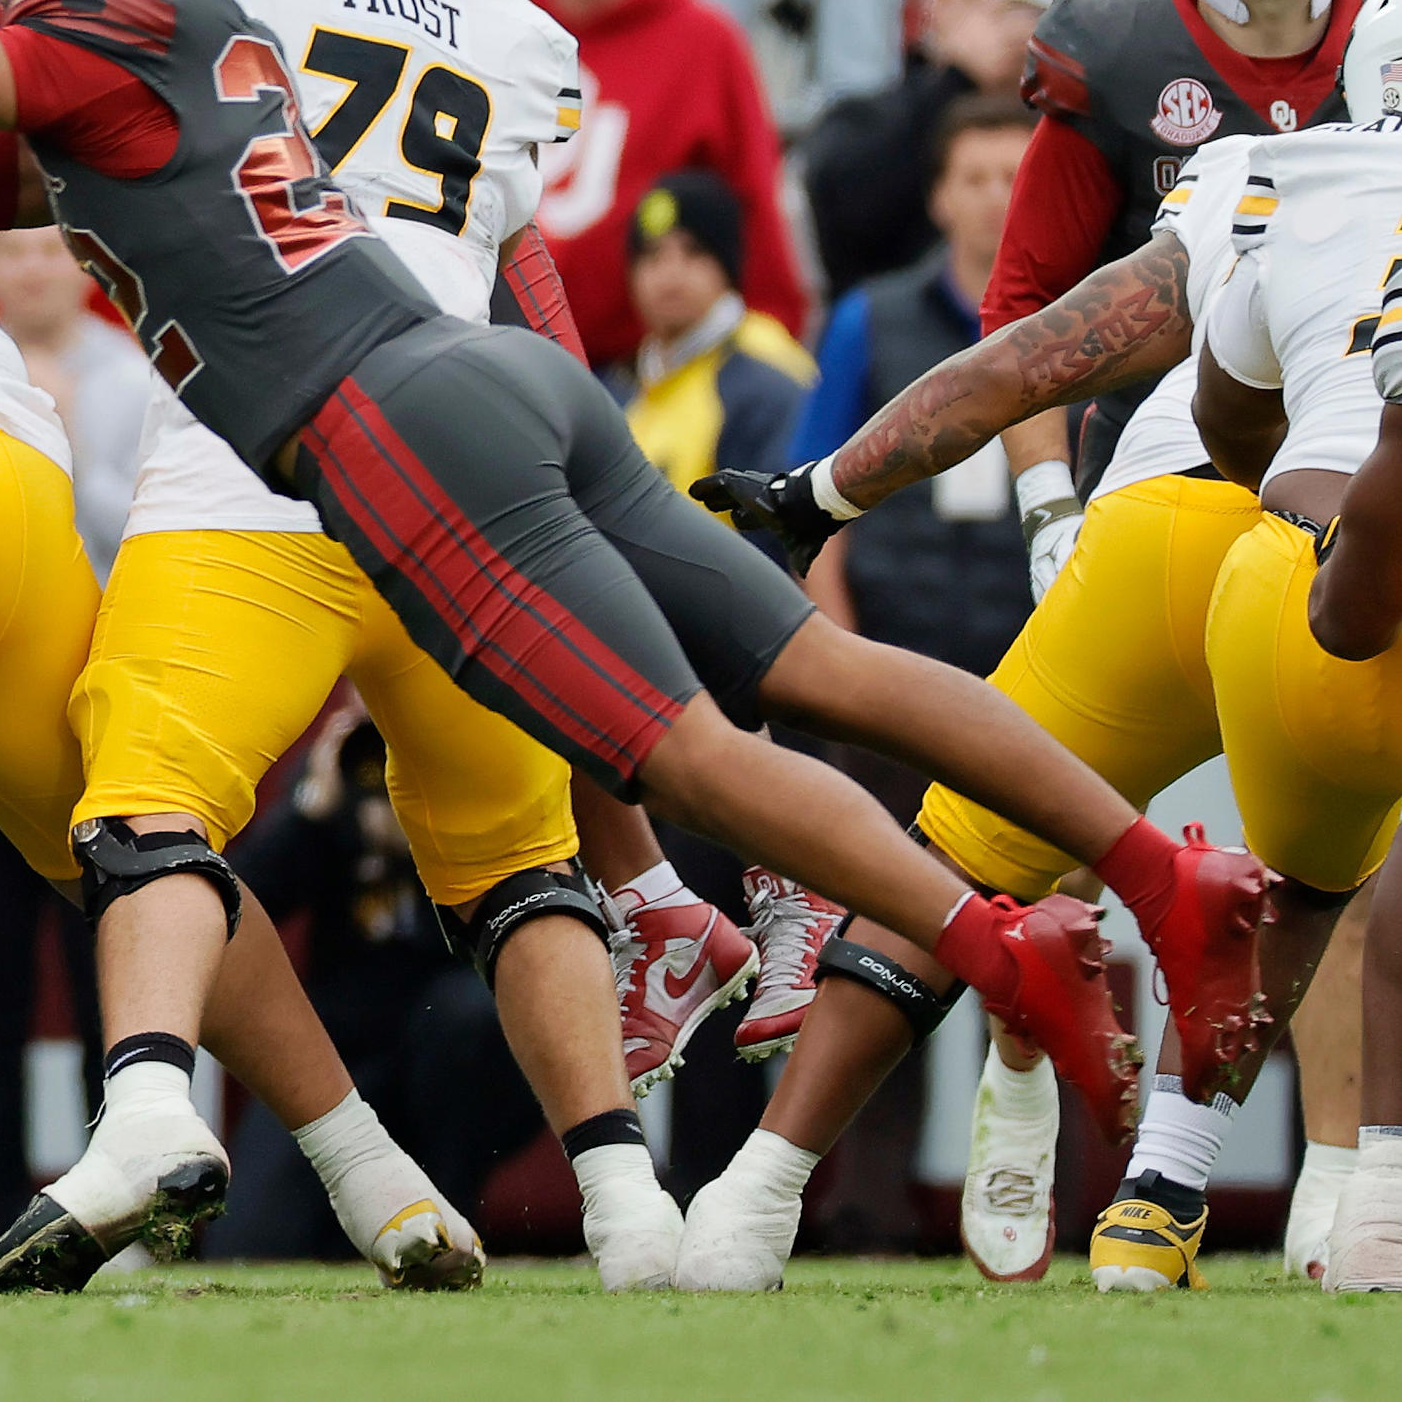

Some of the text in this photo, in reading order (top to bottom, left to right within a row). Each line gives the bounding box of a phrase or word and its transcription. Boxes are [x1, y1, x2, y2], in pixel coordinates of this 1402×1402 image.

[1161, 81, 1211, 128] SEC
[1269, 99, 1298, 133] OU
[297, 23, 493, 239] 79
[1157, 117, 1216, 144] GRADUATE
[489, 889, 557, 931] DONJOY
[857, 955, 924, 1001] DONJOY
[1119, 1206, 1152, 1220] NIKE
